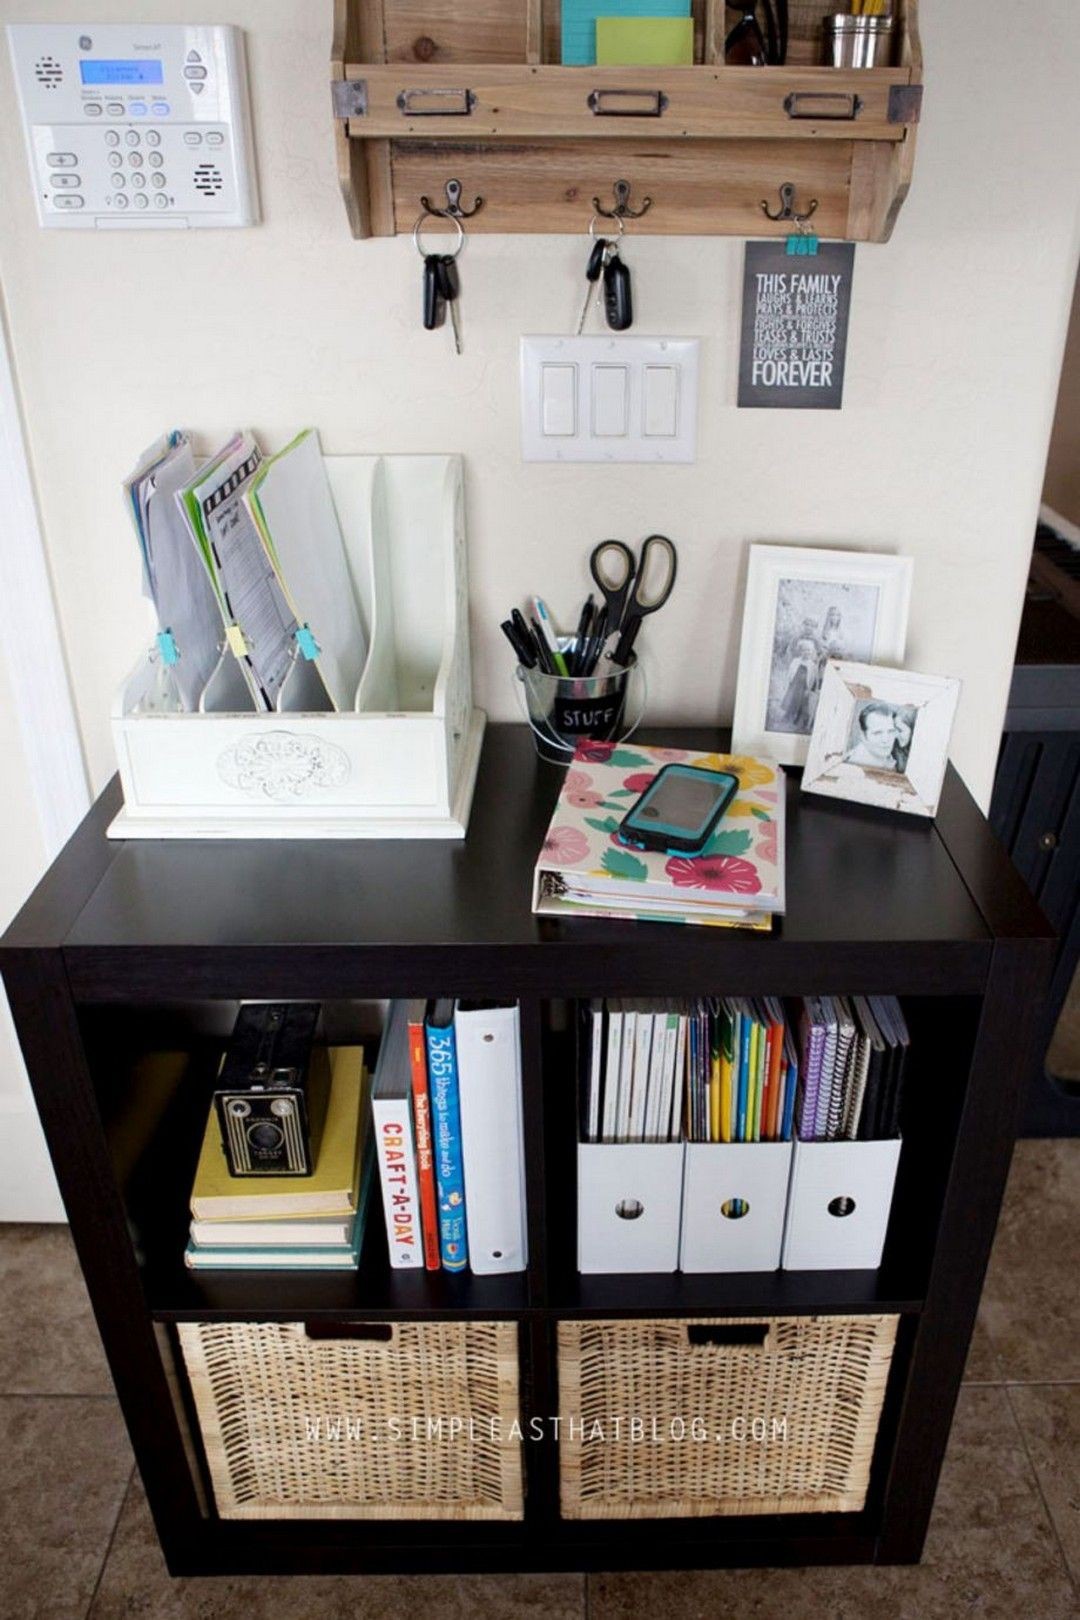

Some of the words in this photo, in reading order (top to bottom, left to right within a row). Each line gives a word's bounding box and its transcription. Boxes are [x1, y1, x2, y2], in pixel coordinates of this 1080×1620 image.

[756, 274, 787, 293] THIS
[790, 274, 841, 293] FAMILY
[757, 293, 791, 304] LAUGHS
[755, 304, 784, 315] PRAYS
[786, 304, 793, 315] &
[796, 304, 837, 316] PROTECTS
[754, 319, 784, 330] FIGHTS
[786, 320, 793, 330] &
[796, 319, 836, 331] FORGIVES
[754, 329, 787, 342] TEASES
[790, 330, 798, 343] &
[801, 329, 835, 343] TRUSTS
[753, 349, 786, 361] LOVES
[790, 349, 798, 361] &
[802, 349, 834, 361] LASTS
[752, 360, 833, 387] FOREVER
[563, 708, 613, 725] STUFF
[429, 1036, 452, 1076] 365
[414, 1092, 428, 1108] The
[433, 1077, 451, 1111] things
[439, 1122, 454, 1149] make
[419, 1149, 432, 1170] Book
[441, 1163, 456, 1177] do
[382, 1123, 415, 1246] CRAFT-A-DAY
